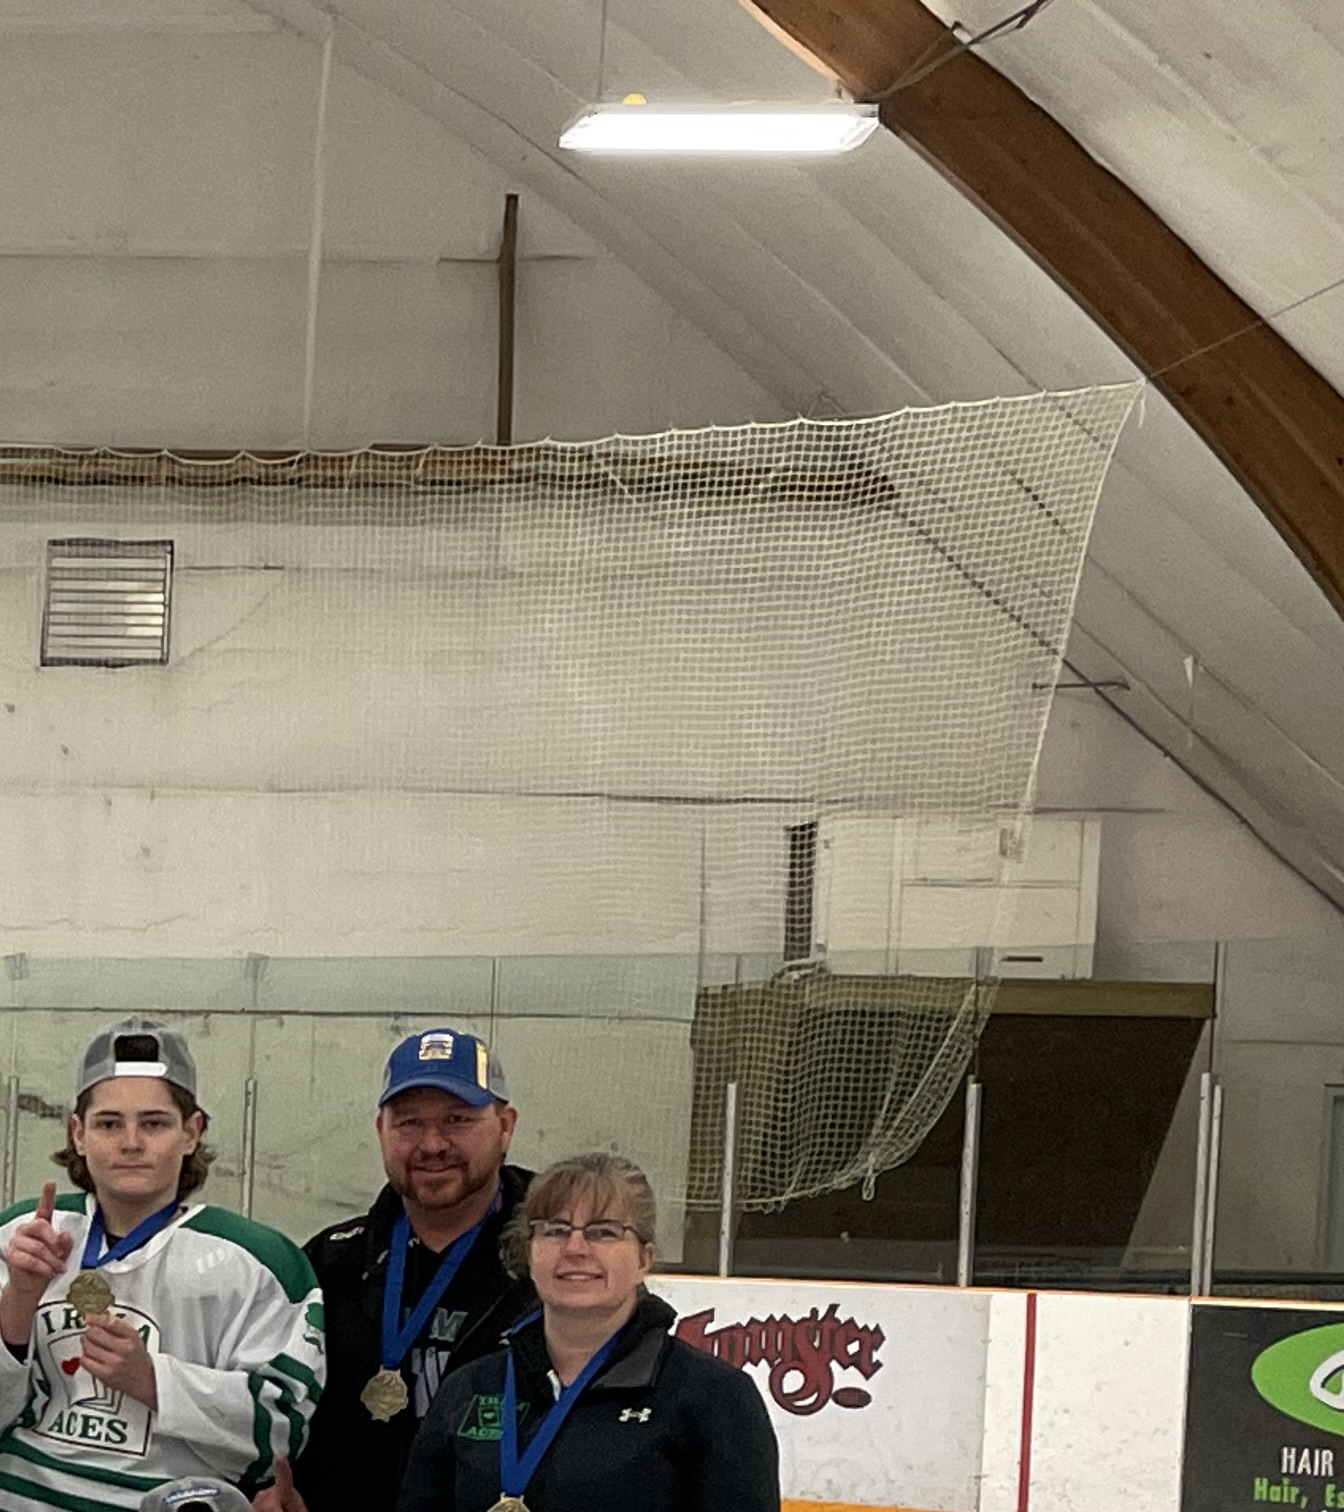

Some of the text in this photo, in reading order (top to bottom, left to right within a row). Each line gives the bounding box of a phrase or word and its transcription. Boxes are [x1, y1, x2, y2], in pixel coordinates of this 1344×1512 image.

[47, 1409, 129, 1446] ACES
[1280, 1446, 1335, 1478] HAIR
[1253, 1476, 1308, 1509] Hair,
